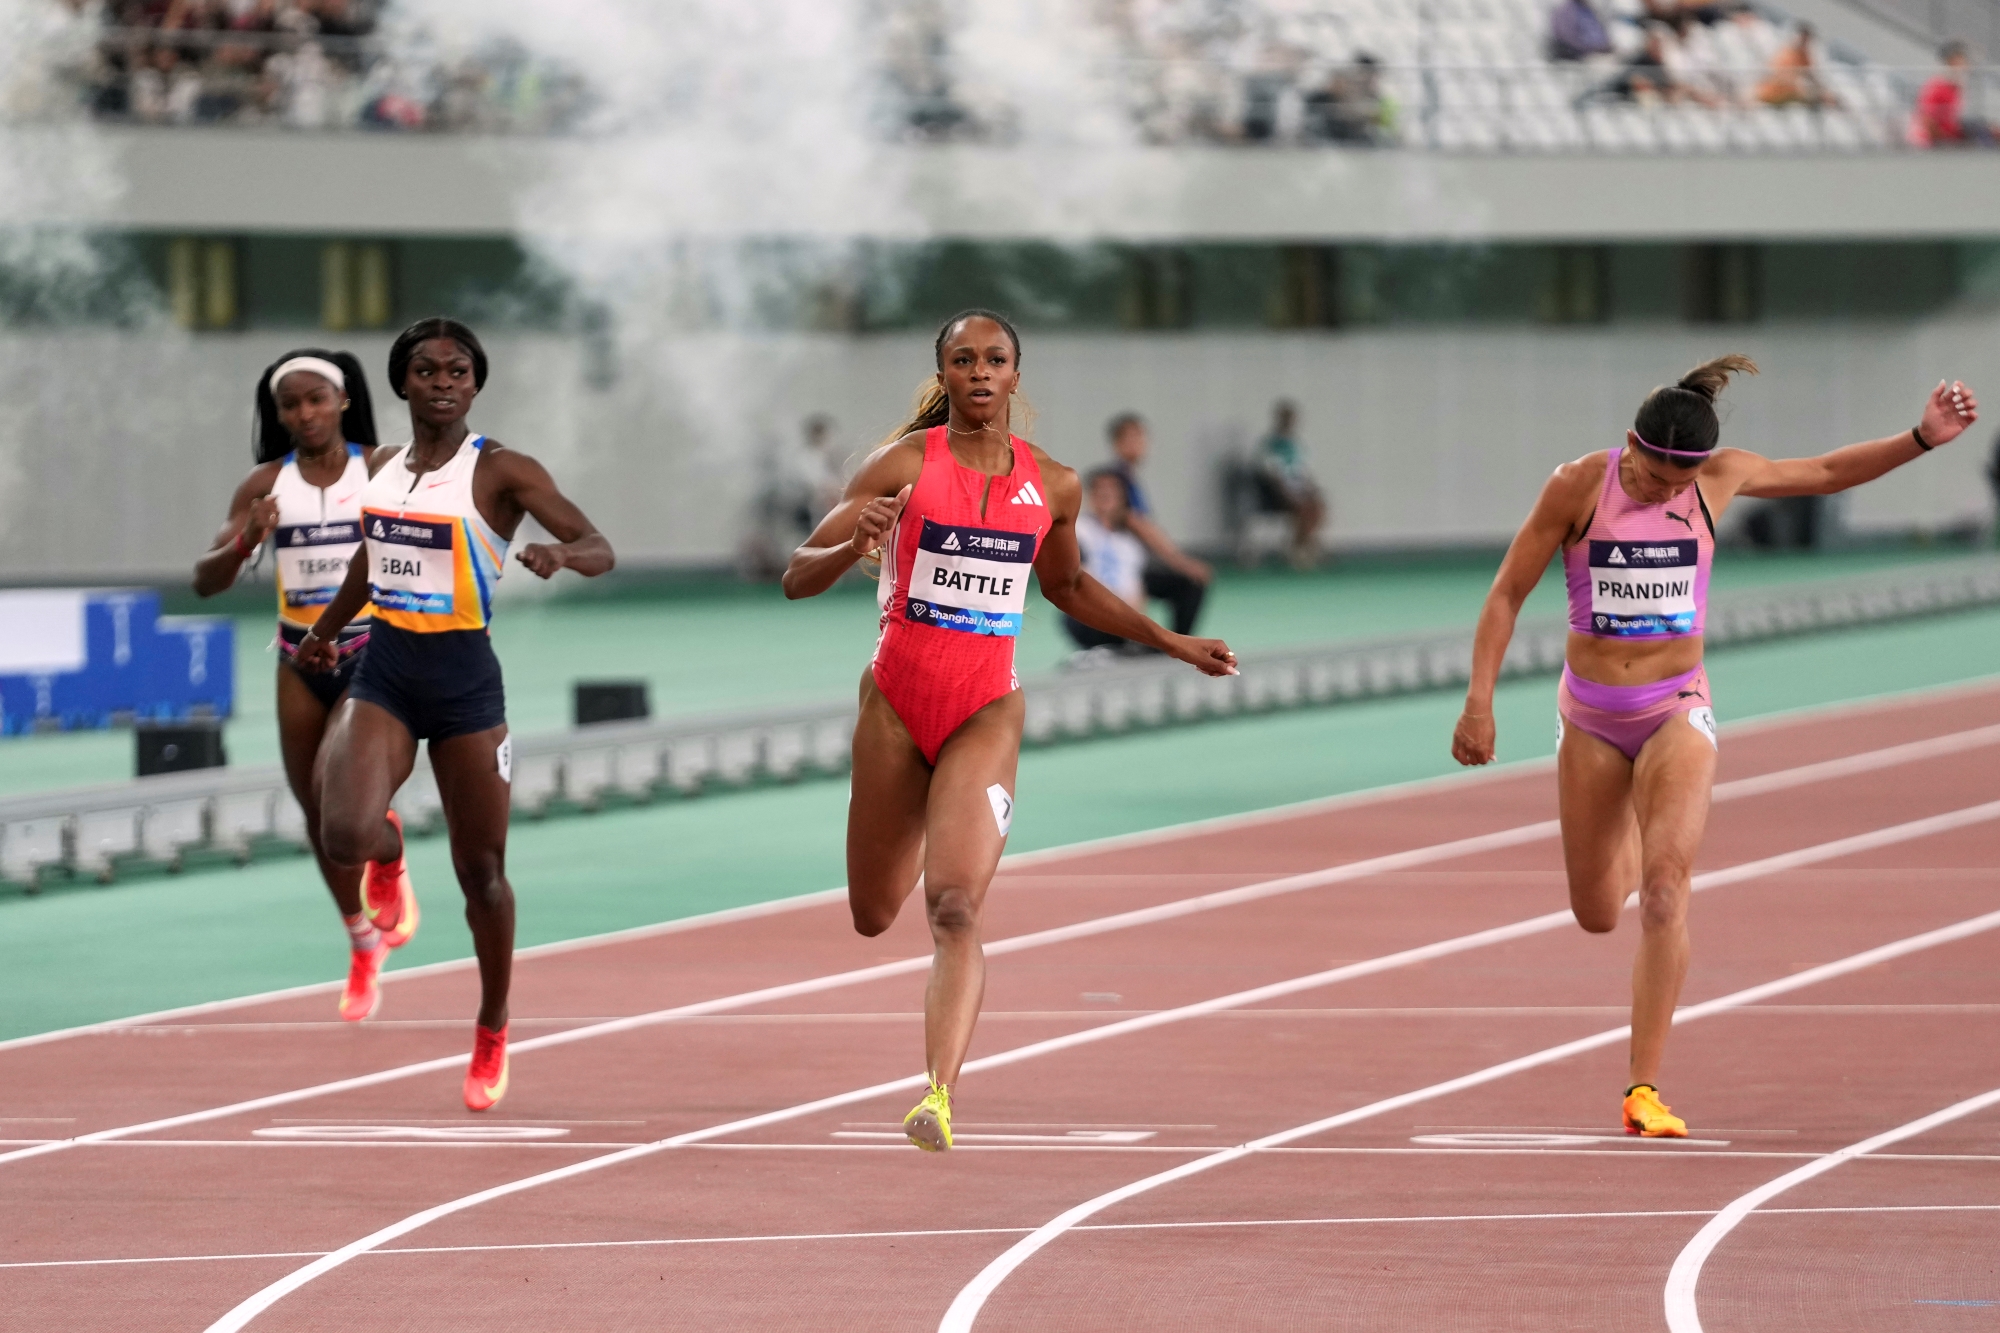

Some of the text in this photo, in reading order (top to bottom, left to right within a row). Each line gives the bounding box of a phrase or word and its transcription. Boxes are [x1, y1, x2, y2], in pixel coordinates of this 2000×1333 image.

[967, 535, 1021, 552] 久事体育
[932, 566, 1014, 596] BATTLE
[1598, 580, 1689, 599] PRANDINI
[929, 609, 977, 625] Shanghai
[984, 618, 1013, 629] Keqiao
[1610, 618, 1654, 630] Shanghai
